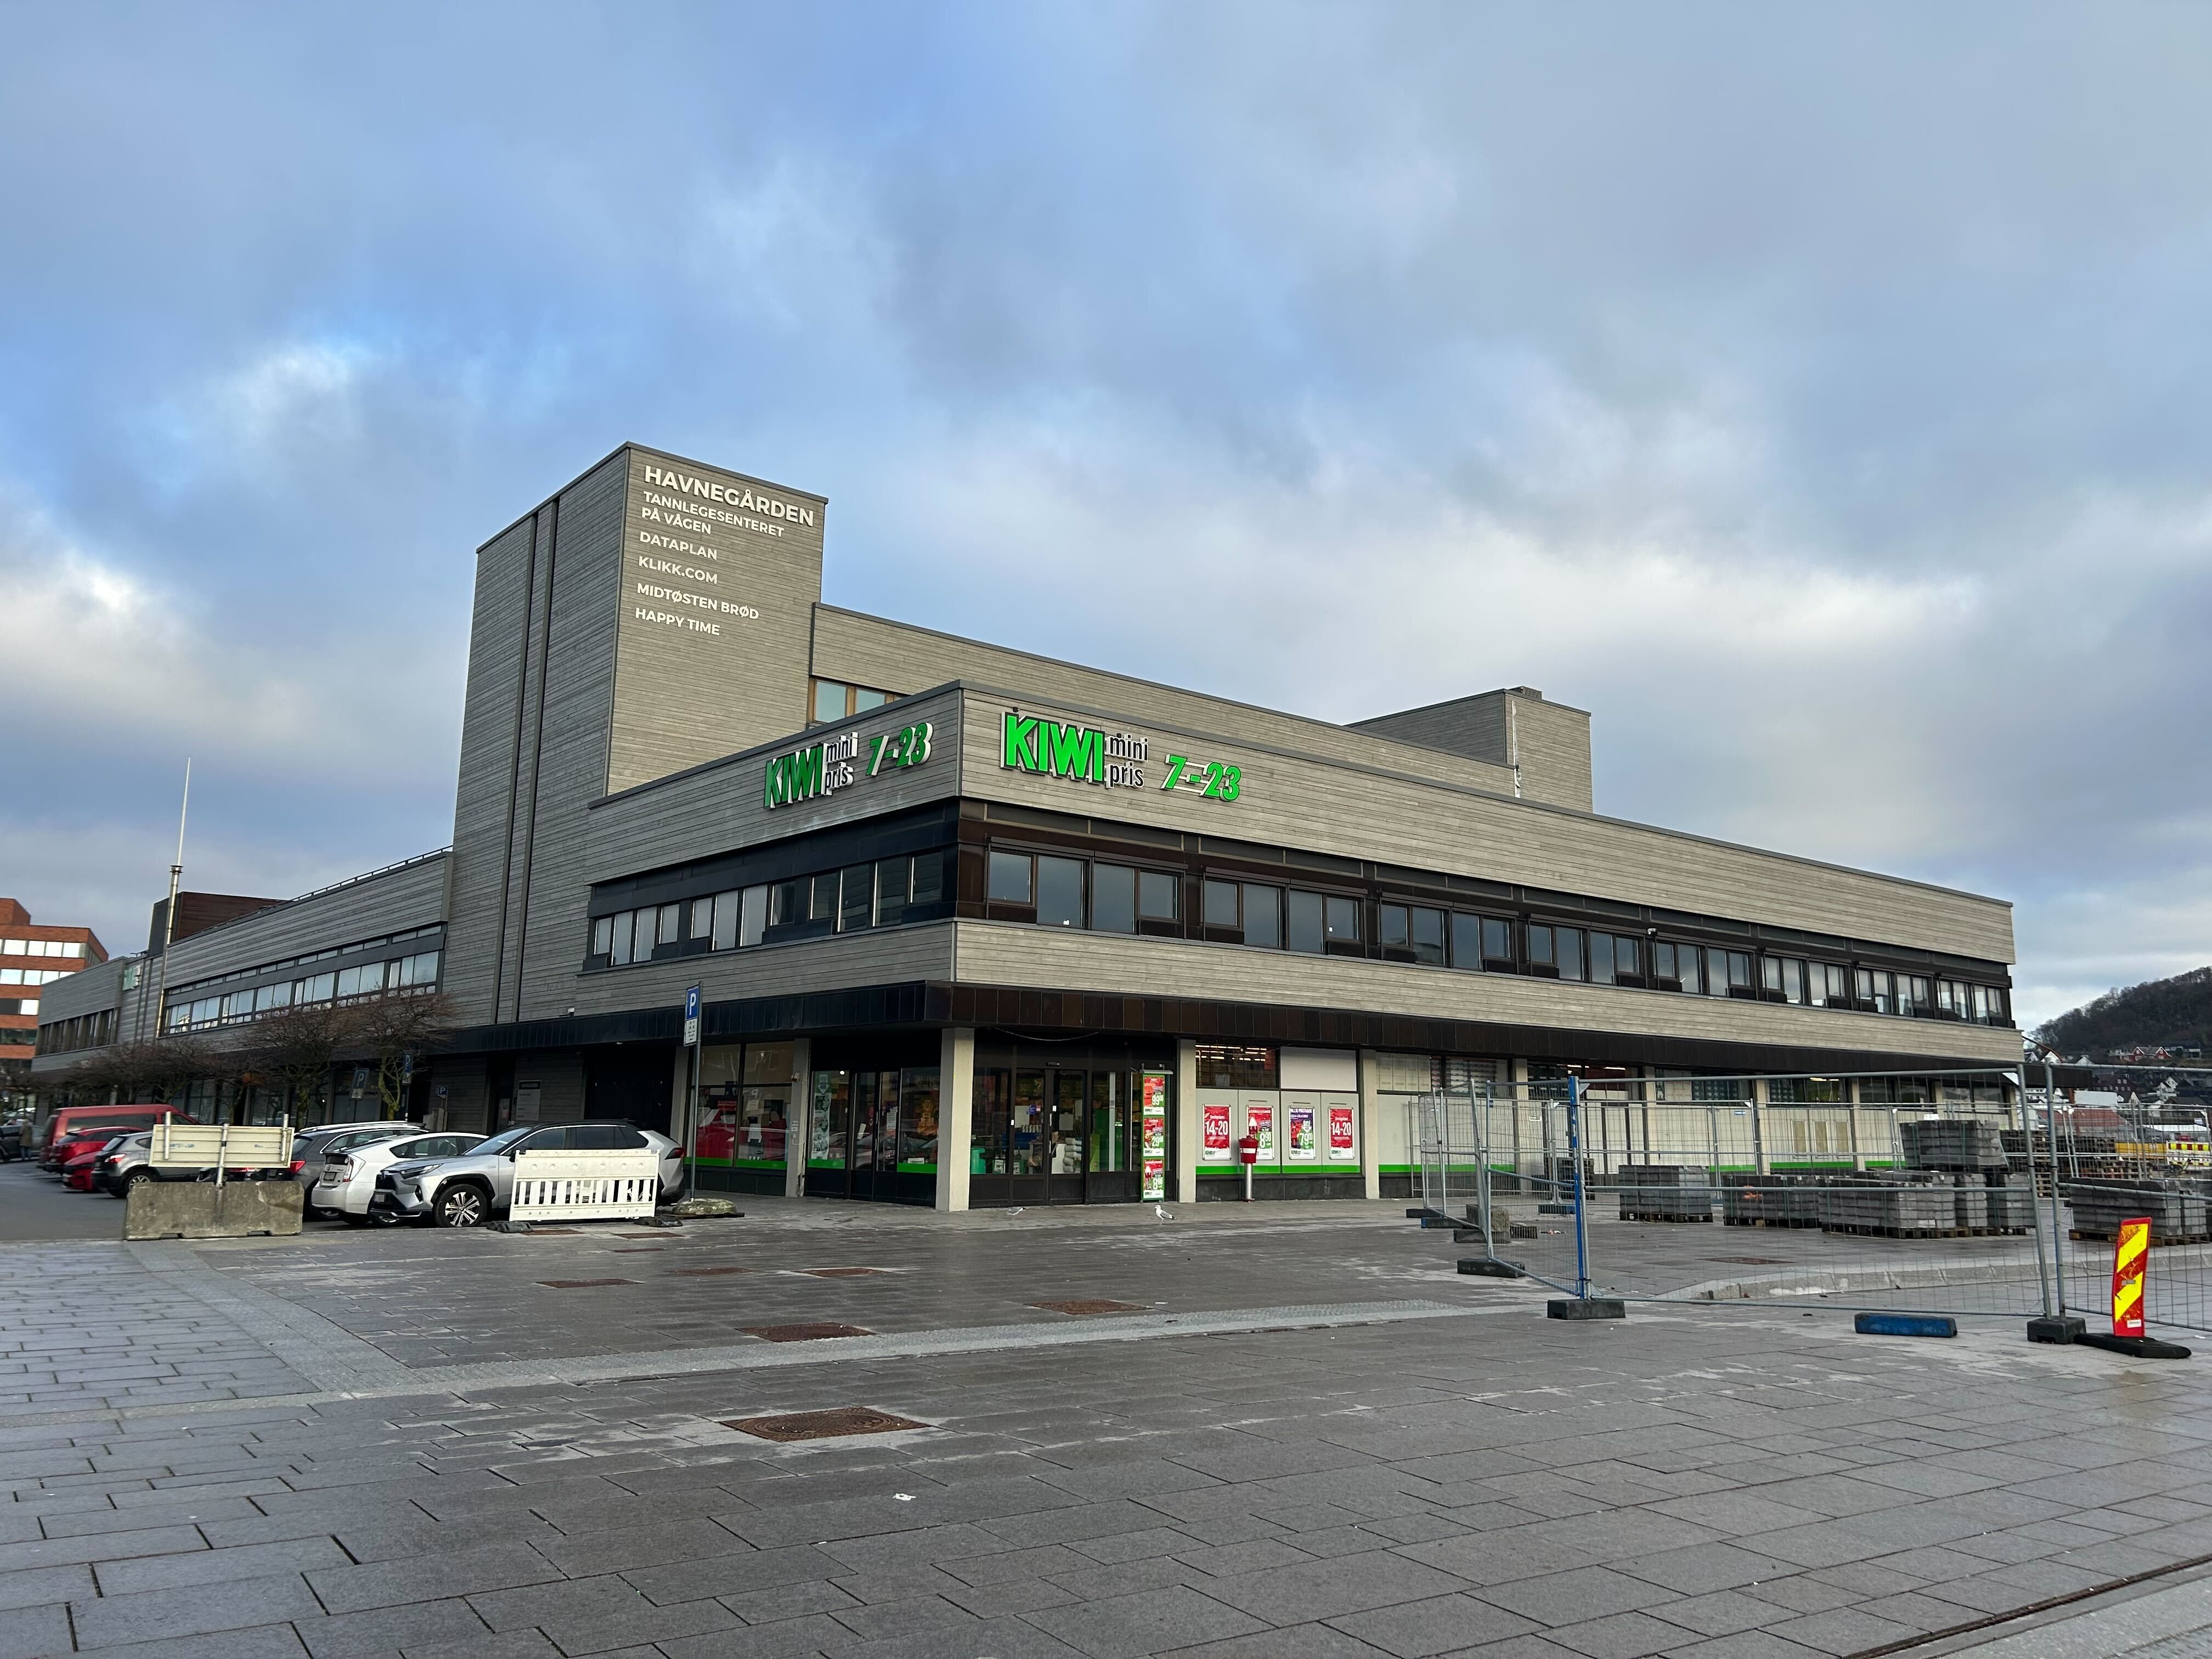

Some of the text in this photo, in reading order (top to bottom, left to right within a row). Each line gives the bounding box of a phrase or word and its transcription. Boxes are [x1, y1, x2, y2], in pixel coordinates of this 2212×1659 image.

[644, 465, 814, 527] HAVNEGÅRDEN
[641, 507, 712, 534] PÅ VÅGEN
[643, 491, 785, 537] TANNLEGESENTERET
[640, 531, 718, 560] DATAPLAN
[639, 555, 718, 584] KLIKK.COM
[637, 583, 759, 620] MIDTØSTEN BRØD
[635, 607, 720, 636] HAPPY TIME
[825, 731, 859, 763] mini
[1001, 712, 1105, 783] KIWI
[1107, 733, 1149, 763] mini
[764, 743, 824, 809] KIWI
[824, 761, 854, 795] pris
[1105, 761, 1144, 789] pris
[689, 992, 697, 1016] P
[1205, 1120, 1228, 1135] 14-20
[1331, 1122, 1352, 1136] 14-20
